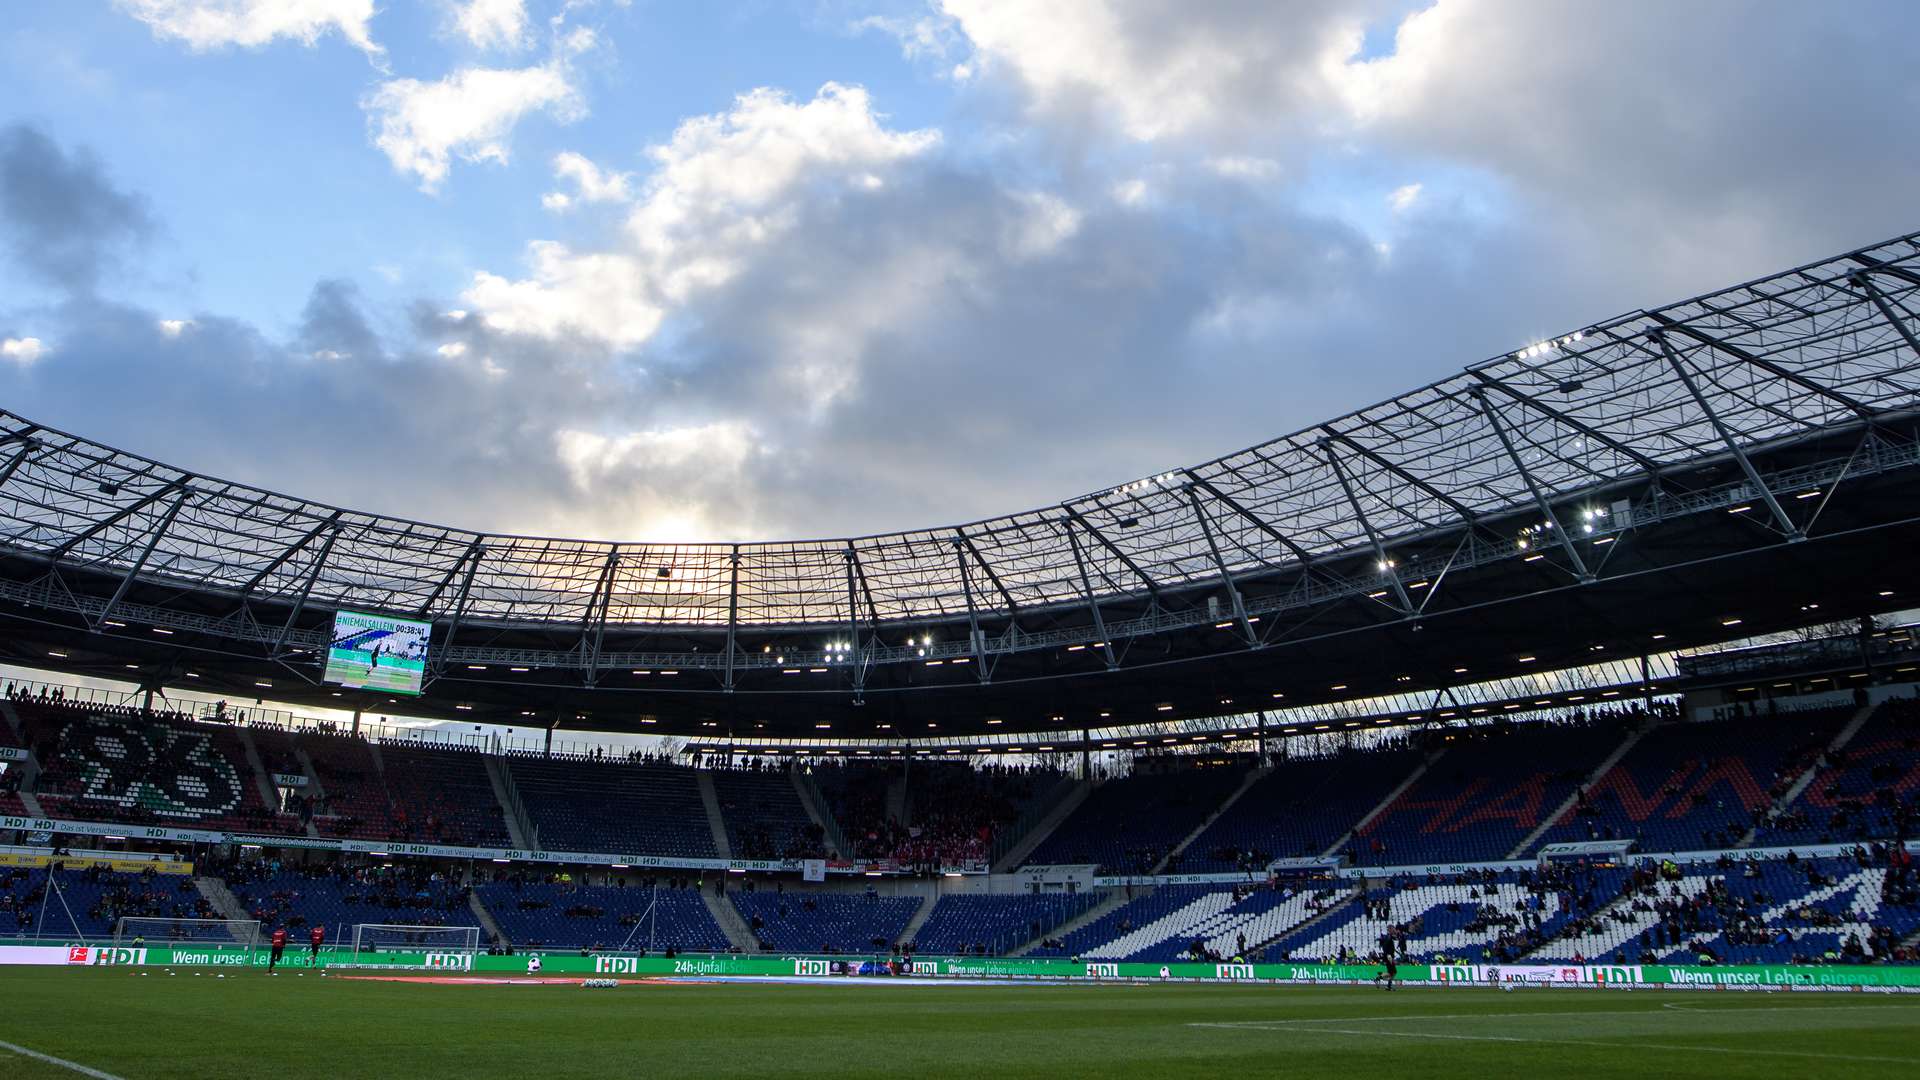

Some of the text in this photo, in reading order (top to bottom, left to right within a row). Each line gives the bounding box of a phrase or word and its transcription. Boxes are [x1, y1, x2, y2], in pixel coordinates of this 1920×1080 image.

[336, 615, 425, 636] #NIEMALSALLEIN 00:38:41
[280, 775, 300, 784] HDI
[4, 817, 27, 828] HDI
[34, 820, 56, 830] HDI
[60, 824, 75, 832] Das
[76, 825, 86, 833] ist
[87, 825, 133, 837] Versicherung
[387, 844, 406, 852] HDI
[410, 845, 429, 854] HDI
[504, 851, 523, 859] HDI
[531, 852, 549, 860] HDI
[620, 856, 638, 864] HDI
[642, 857, 660, 865] HDI
[752, 861, 769, 869] HDI
[95, 949, 143, 966] HDI
[172, 951, 209, 964] Wenn
[212, 951, 249, 965] unser
[600, 958, 633, 973] HDI
[799, 961, 828, 975] HDI
[1220, 964, 1251, 978] HDI
[1436, 966, 1473, 981] HDI
[1592, 967, 1641, 983] HDI
[1669, 968, 1713, 983] Wenn
[1717, 971, 1761, 985] unser
[1765, 969, 1814, 986] Leben
